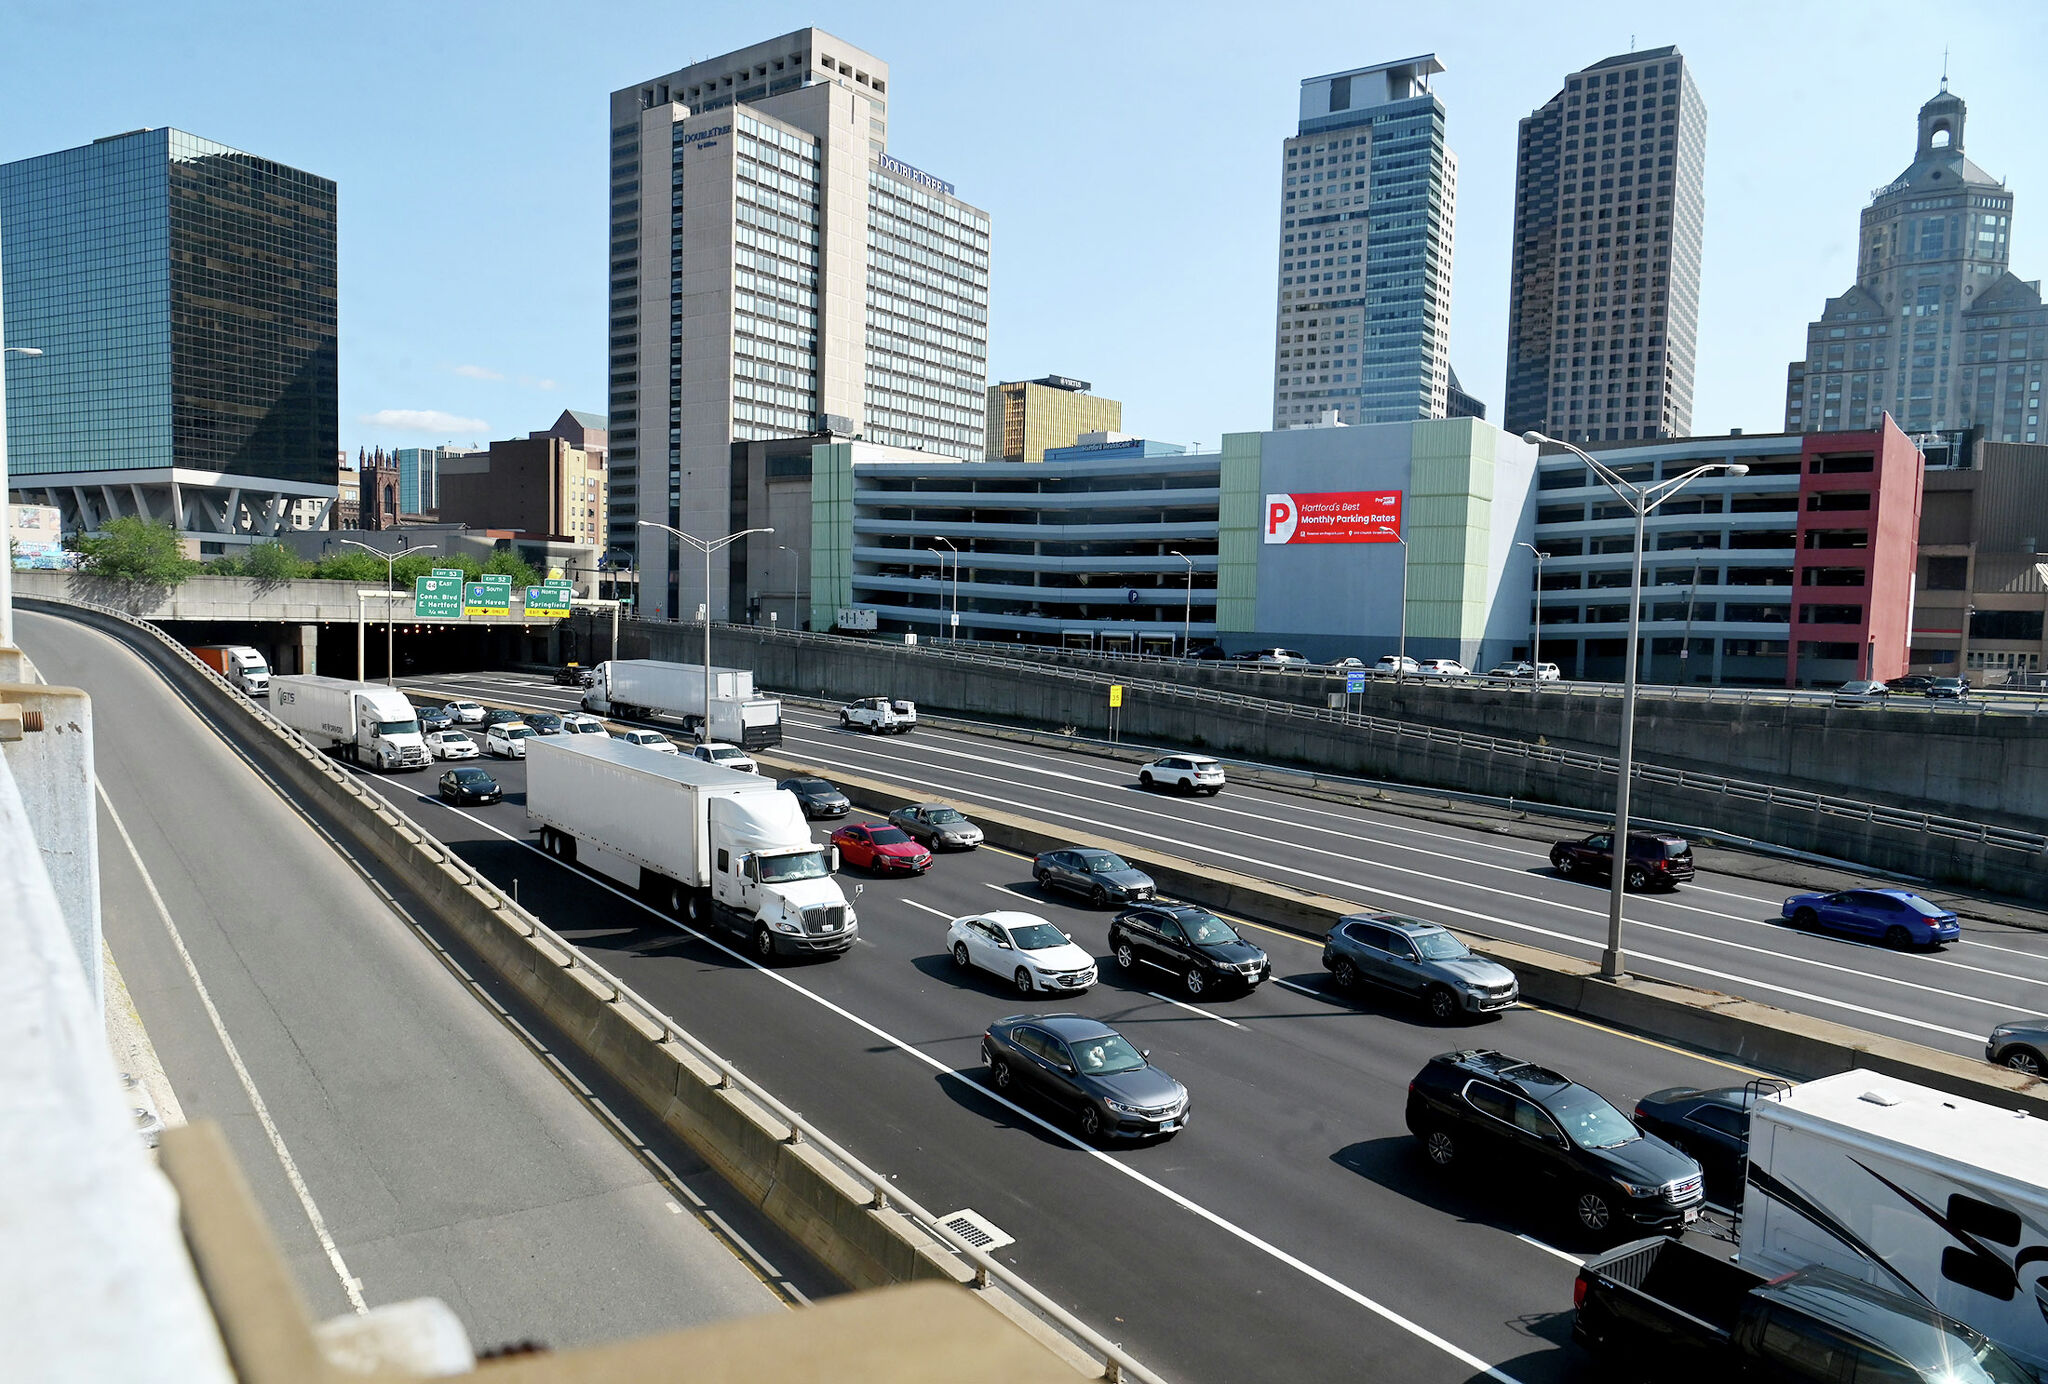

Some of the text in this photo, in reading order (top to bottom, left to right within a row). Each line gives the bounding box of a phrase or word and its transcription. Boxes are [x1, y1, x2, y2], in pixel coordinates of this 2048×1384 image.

[880, 153, 943, 193] DOUBLETREE
[1301, 502, 1360, 512] Hartford's Best
[1269, 503, 1291, 535] P
[1301, 514, 1396, 526] Monthly Parking Rates
[428, 601, 458, 609] Hartford
[530, 601, 566, 609] Springfield
[282, 691, 295, 703] GTS
